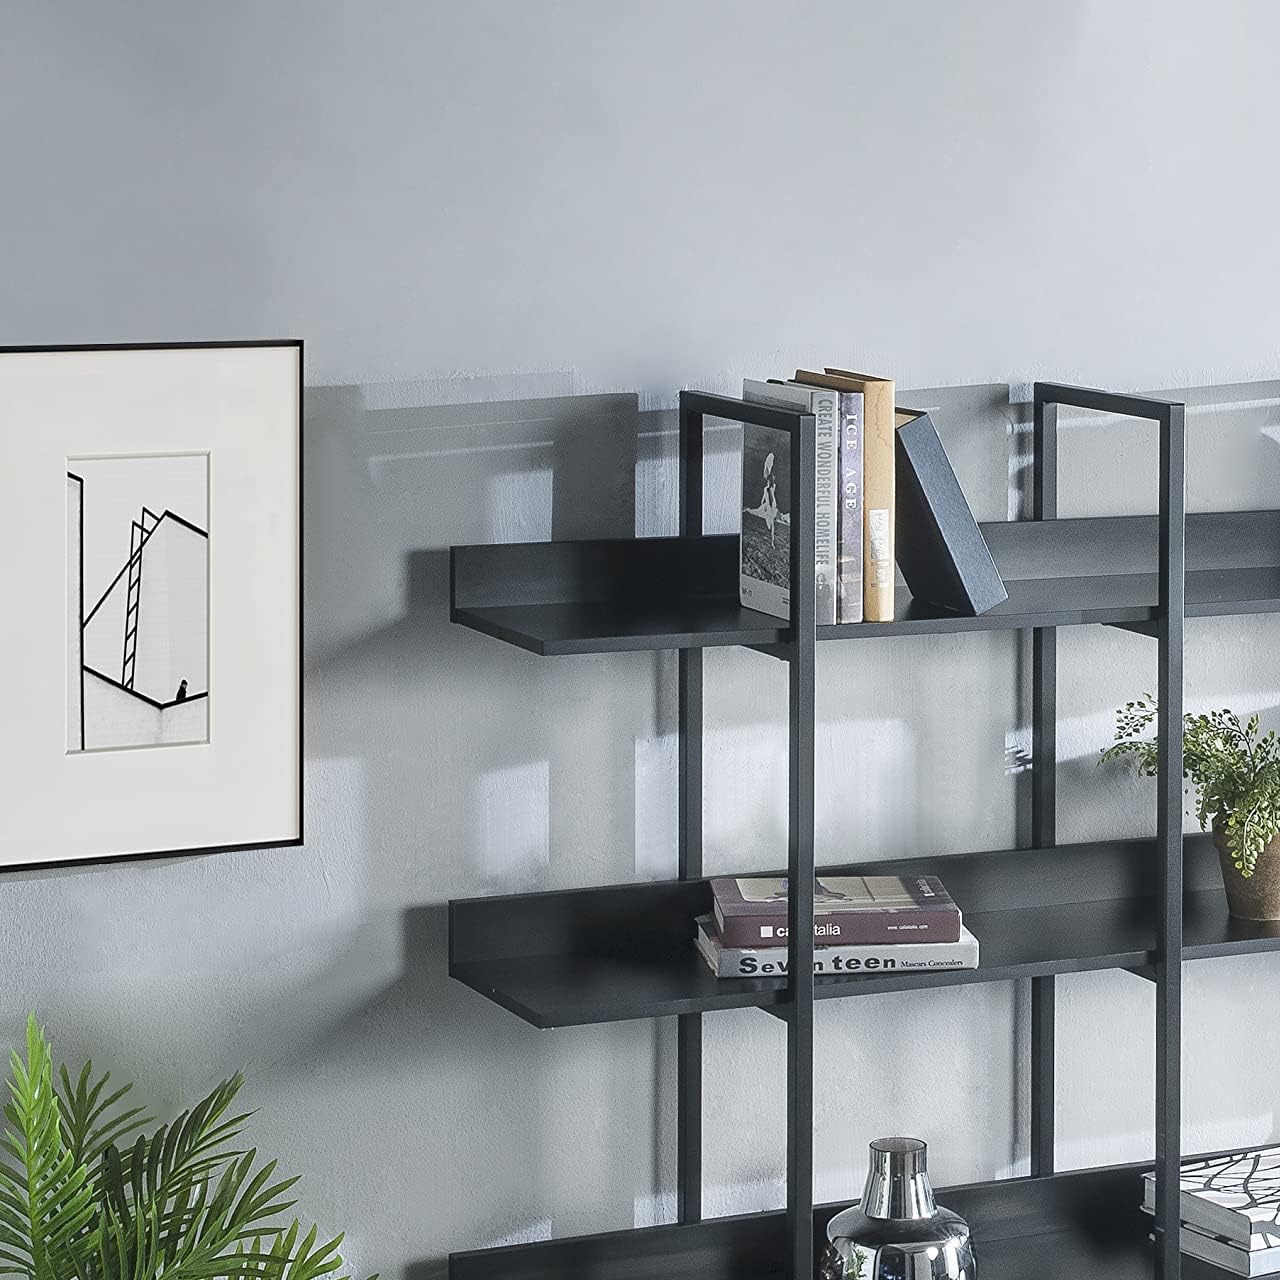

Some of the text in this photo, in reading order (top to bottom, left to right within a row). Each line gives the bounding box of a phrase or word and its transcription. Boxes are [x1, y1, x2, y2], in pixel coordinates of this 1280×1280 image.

[815, 398, 833, 565] CREATE WONDERFUL HOMELIFE
[846, 414, 857, 509] ICE AGE
[738, 955, 896, 974] Sevn teen
